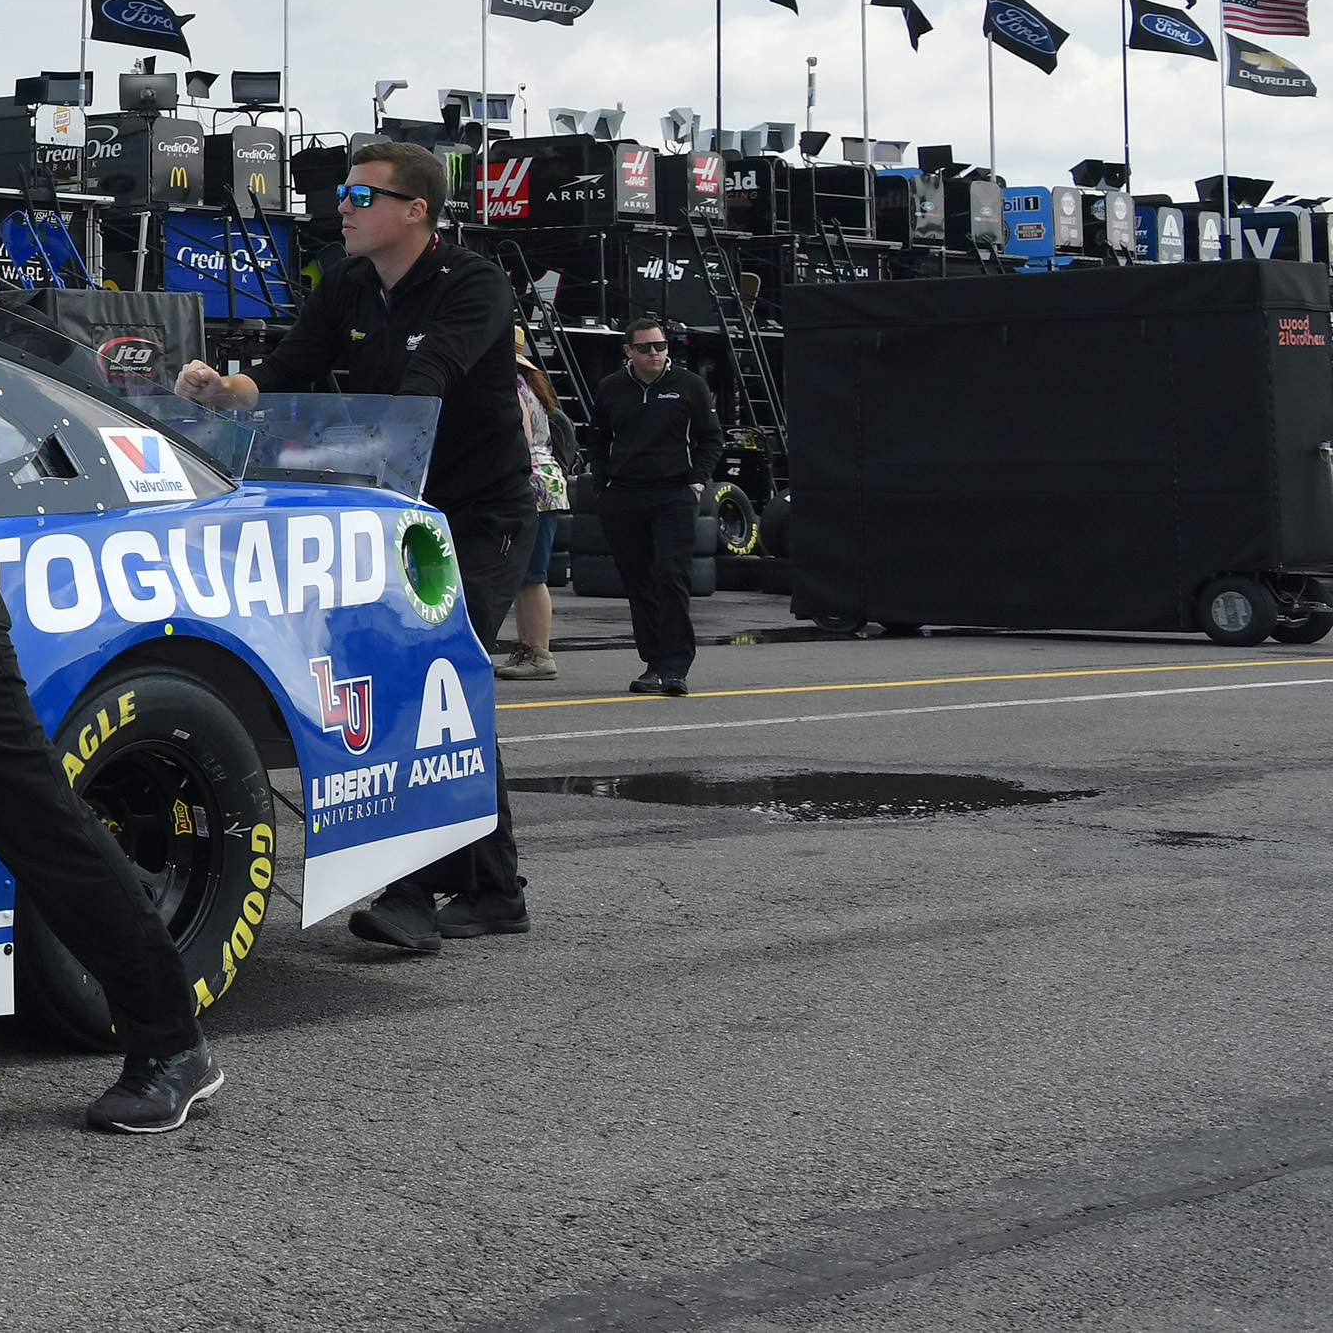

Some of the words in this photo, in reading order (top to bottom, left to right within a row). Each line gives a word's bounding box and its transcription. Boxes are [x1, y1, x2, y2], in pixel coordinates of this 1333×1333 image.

[996, 8, 1049, 46] Ford
[1154, 17, 1191, 44] Ford
[1239, 68, 1309, 88] CHEVROLET
[545, 188, 606, 202] ARRIS
[623, 199, 650, 210] ARRIS
[1161, 238, 1182, 246] AXALTA
[1201, 240, 1222, 249] AXALTA
[1278, 314, 1310, 330] wood
[114, 344, 153, 364] jtg
[109, 363, 153, 373] Daugherty
[727, 467, 740, 476] 42
[129, 479, 184, 494] Valvoline
[395, 509, 452, 559] AMERICAN
[403, 581, 458, 623] ETHANOL
[61, 690, 137, 789] AGLE
[407, 747, 484, 789] AXALTA
[310, 760, 399, 811] LIBERTY
[176, 805, 188, 830] AERO
[310, 794, 397, 833] UNIVERSITY
